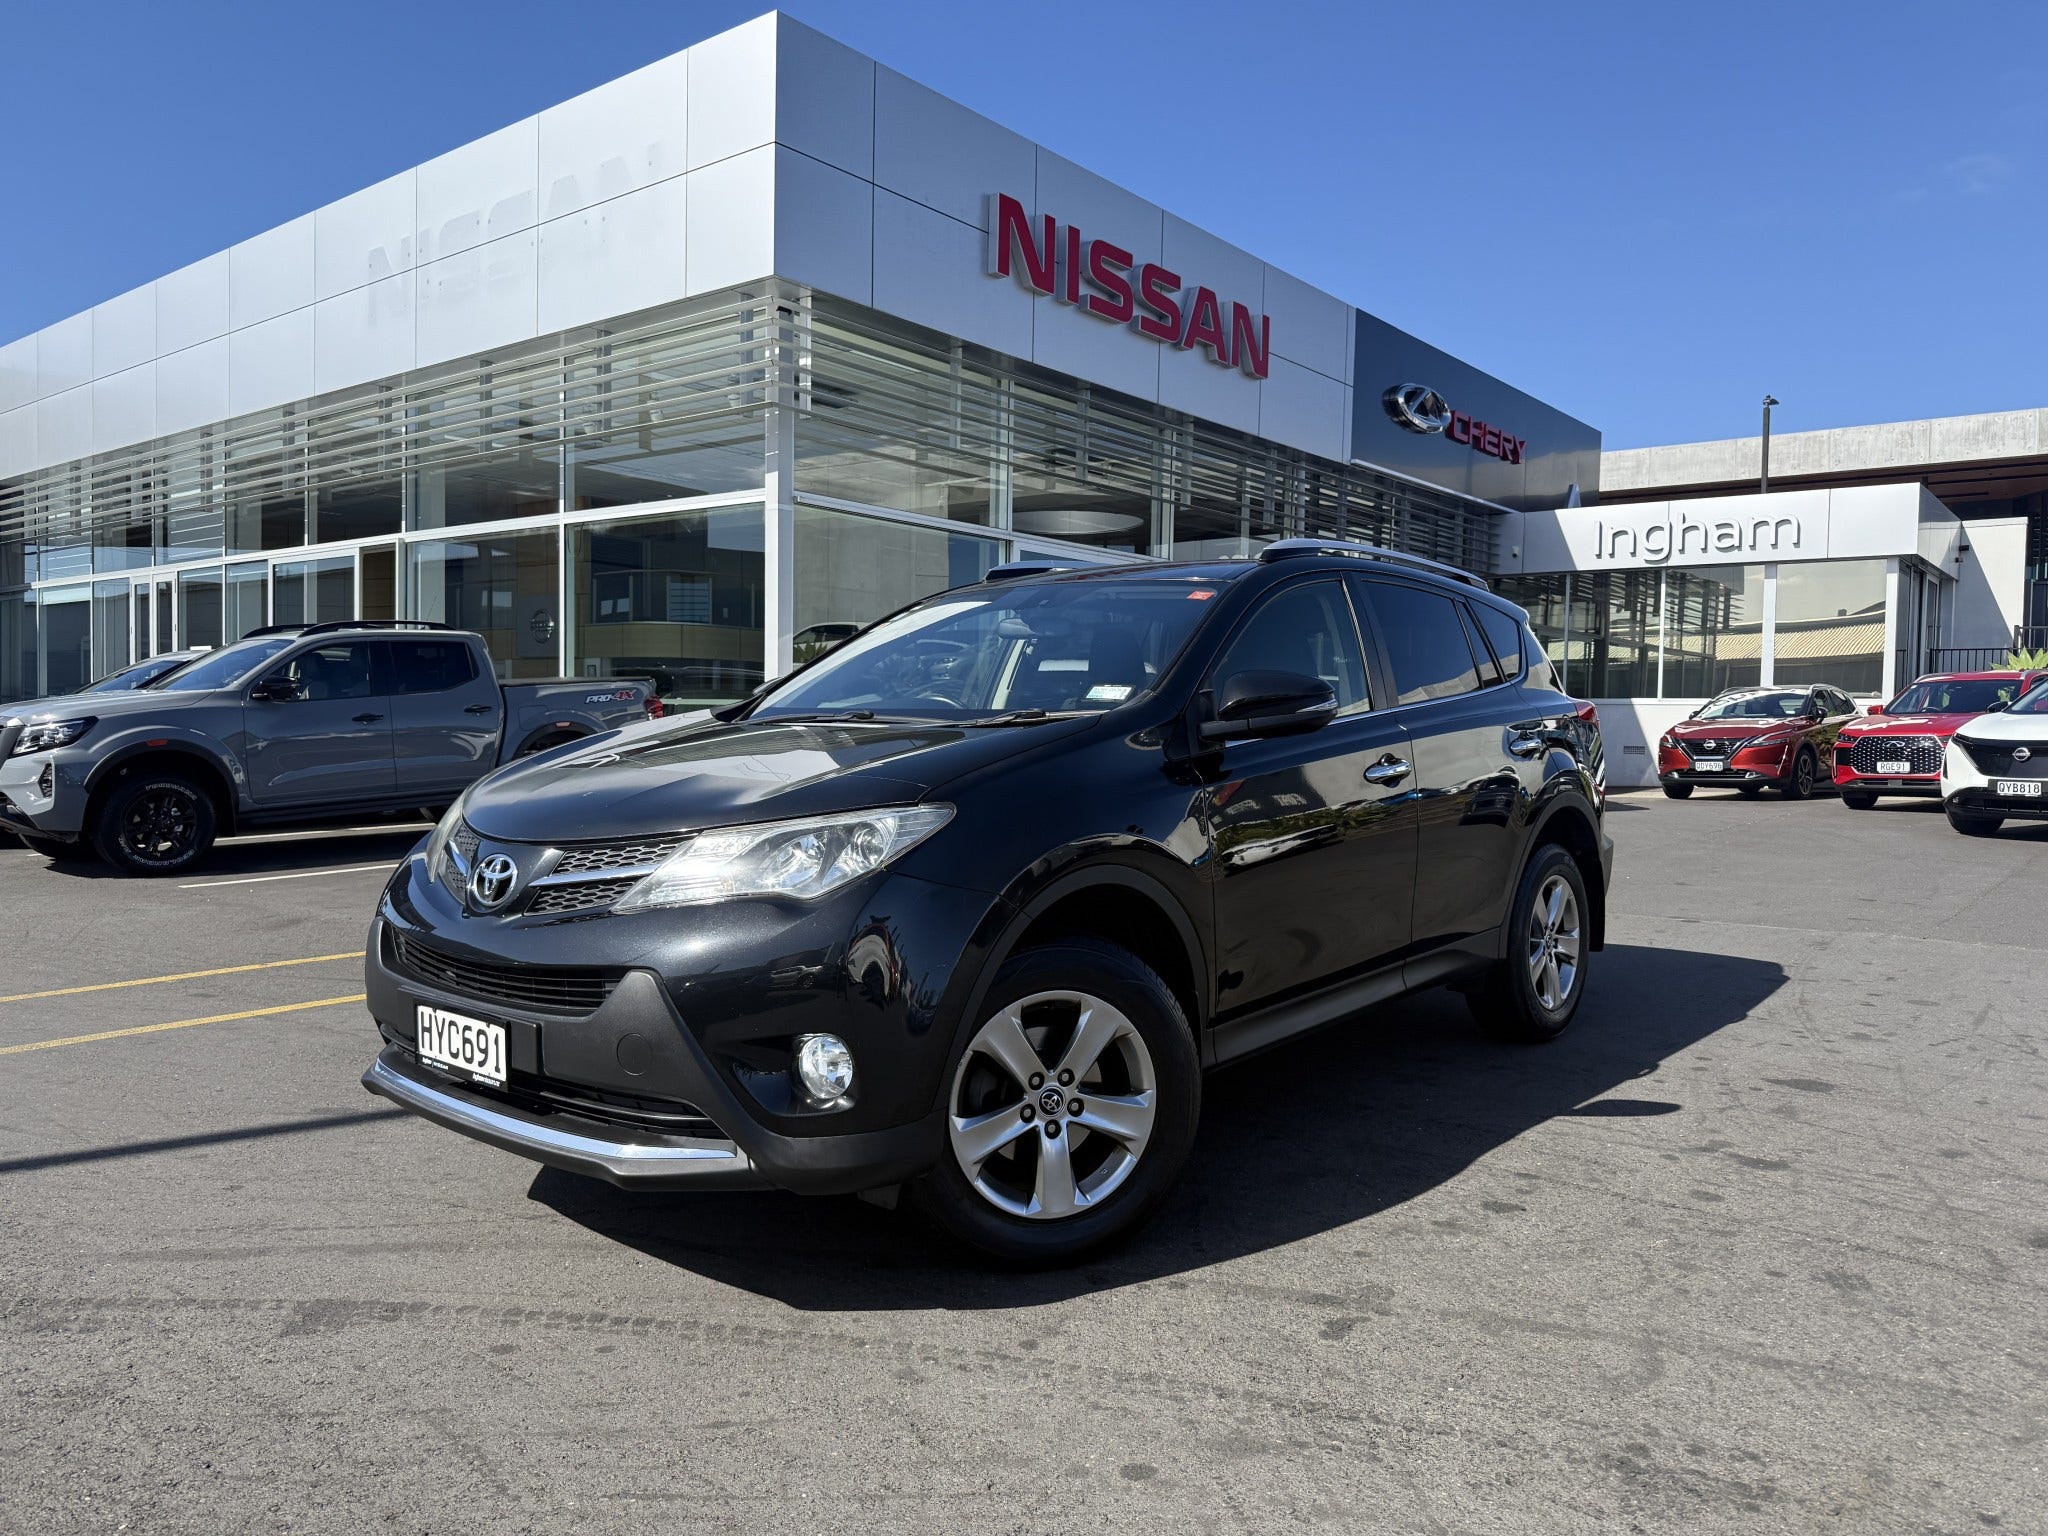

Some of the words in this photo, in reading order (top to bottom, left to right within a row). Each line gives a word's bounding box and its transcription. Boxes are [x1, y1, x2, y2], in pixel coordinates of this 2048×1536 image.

[988, 192, 1270, 379] NISSAN
[1447, 410, 1527, 464] CHERY
[1594, 503, 1800, 565] Ingham
[1998, 782, 2040, 794] QYB818
[420, 1010, 501, 1074] HYC691
